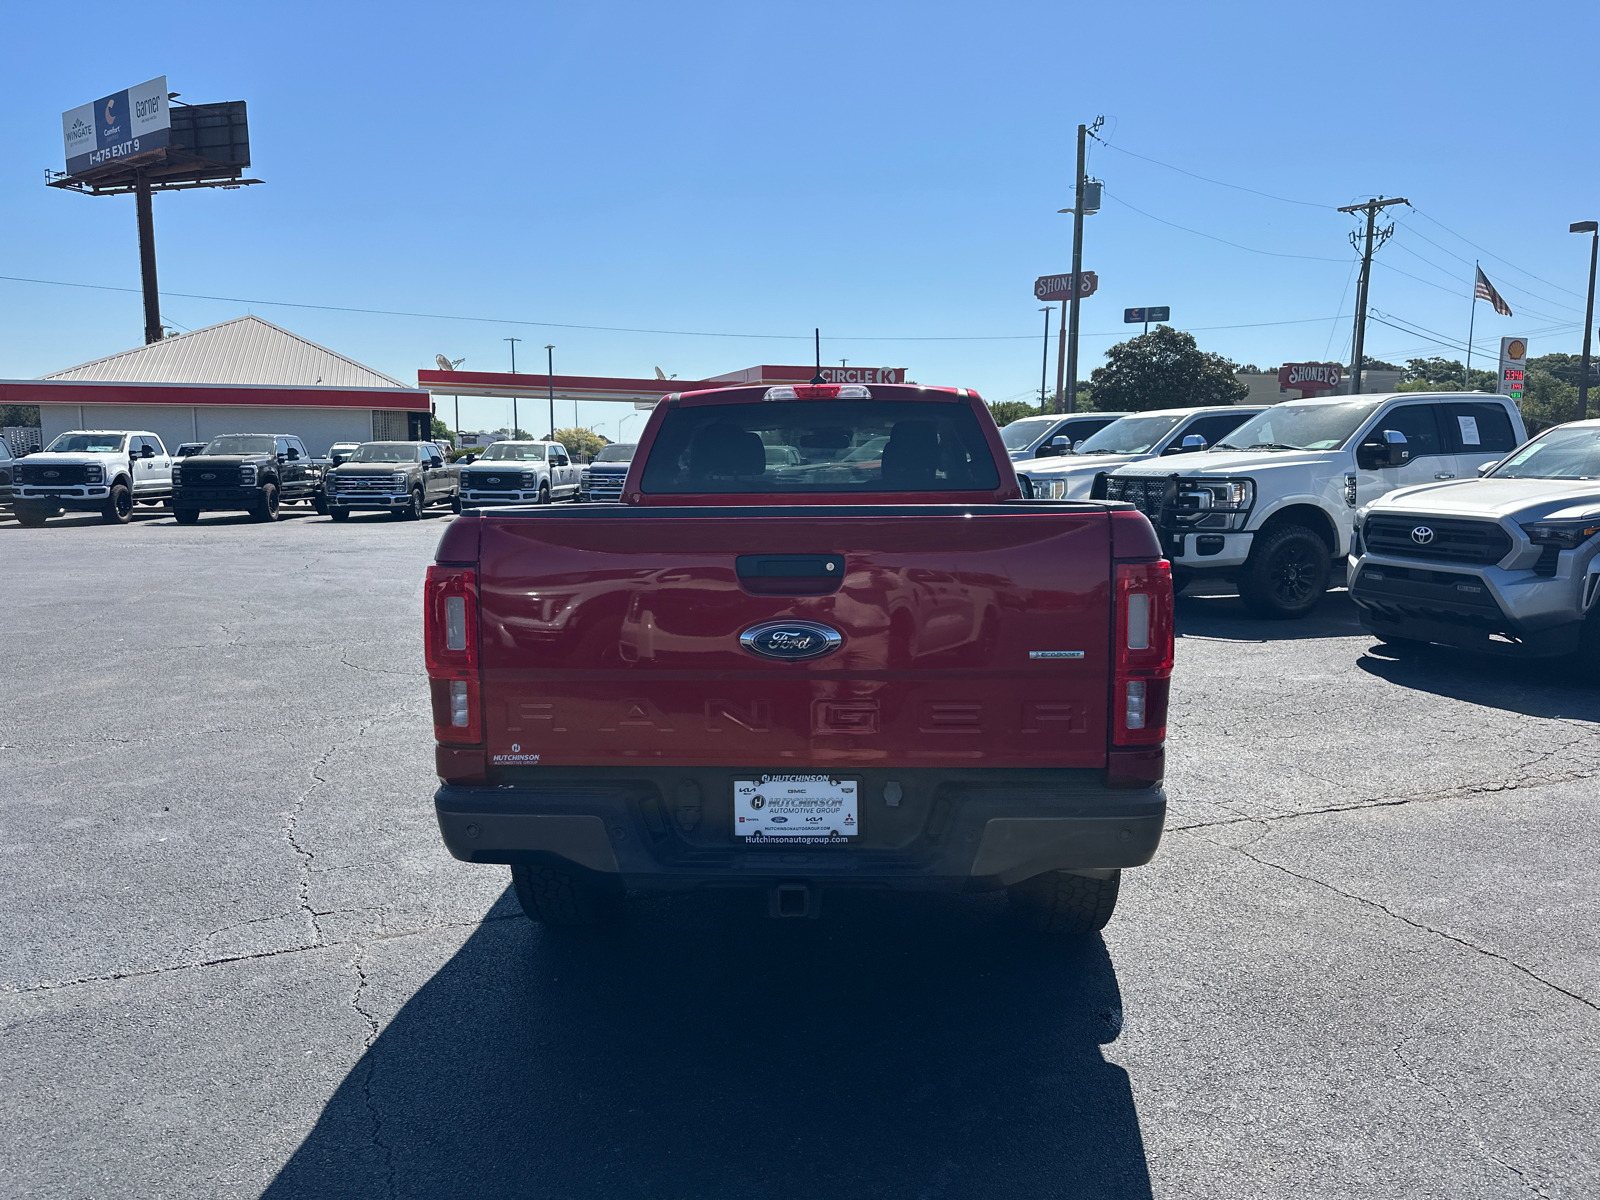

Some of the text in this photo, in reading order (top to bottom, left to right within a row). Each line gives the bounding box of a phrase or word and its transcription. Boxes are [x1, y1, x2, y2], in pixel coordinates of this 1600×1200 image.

[135, 96, 160, 118] Garner
[66, 126, 92, 142] WINGATE
[103, 126, 121, 136] Comfort
[89, 149, 111, 165] I-475
[112, 141, 132, 157] EXIT
[134, 139, 140, 151] 9
[820, 369, 893, 384] CIRCLE K
[1288, 366, 1339, 385] SHONEY'S
[768, 631, 812, 650] Ford
[503, 697, 1088, 734] RANGER
[768, 798, 843, 807] HUTCHINSON
[745, 835, 848, 844] Hutchinsonautogroup.com
